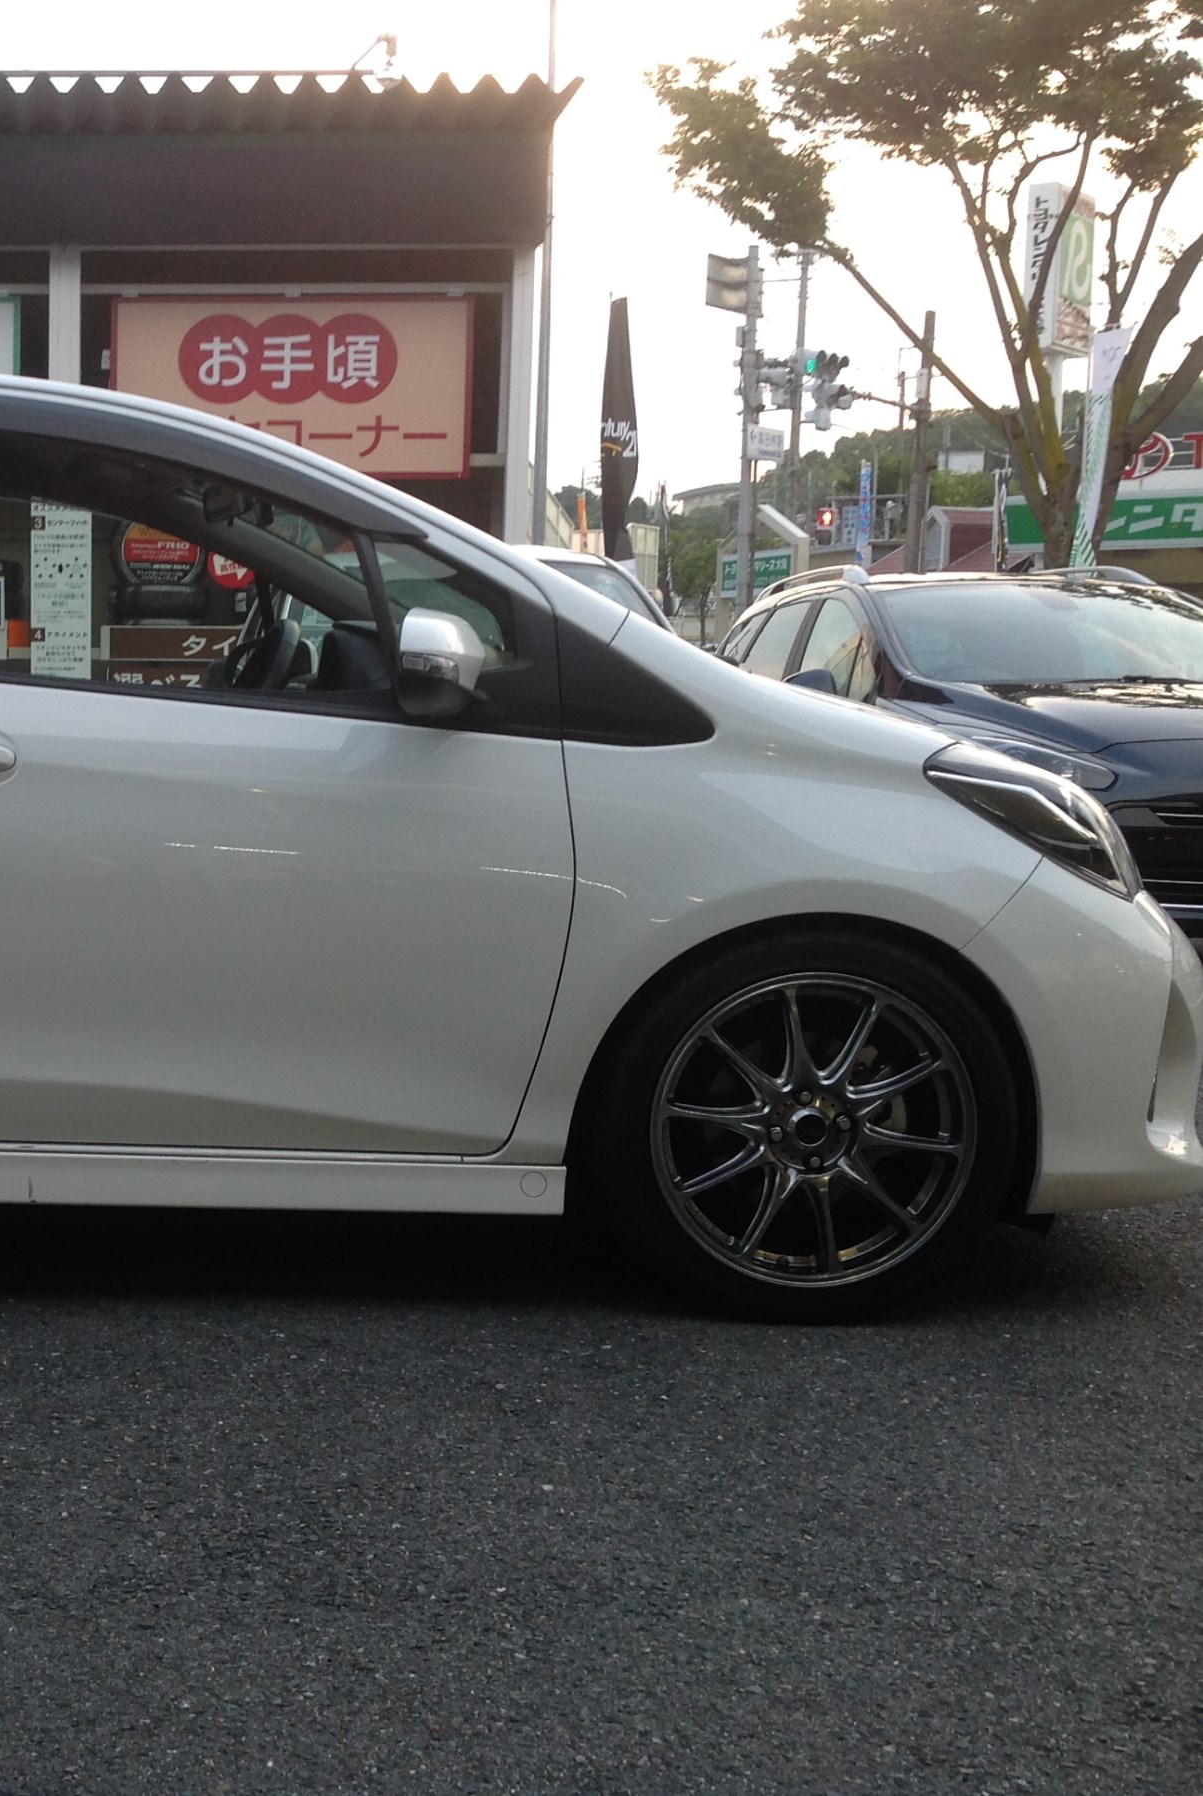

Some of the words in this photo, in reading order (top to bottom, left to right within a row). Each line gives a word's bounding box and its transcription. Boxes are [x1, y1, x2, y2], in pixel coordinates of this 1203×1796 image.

[198, 333, 380, 391] お手頃
[229, 414, 447, 457] コーナー
[34, 517, 43, 529] 3
[33, 629, 42, 640] 4
